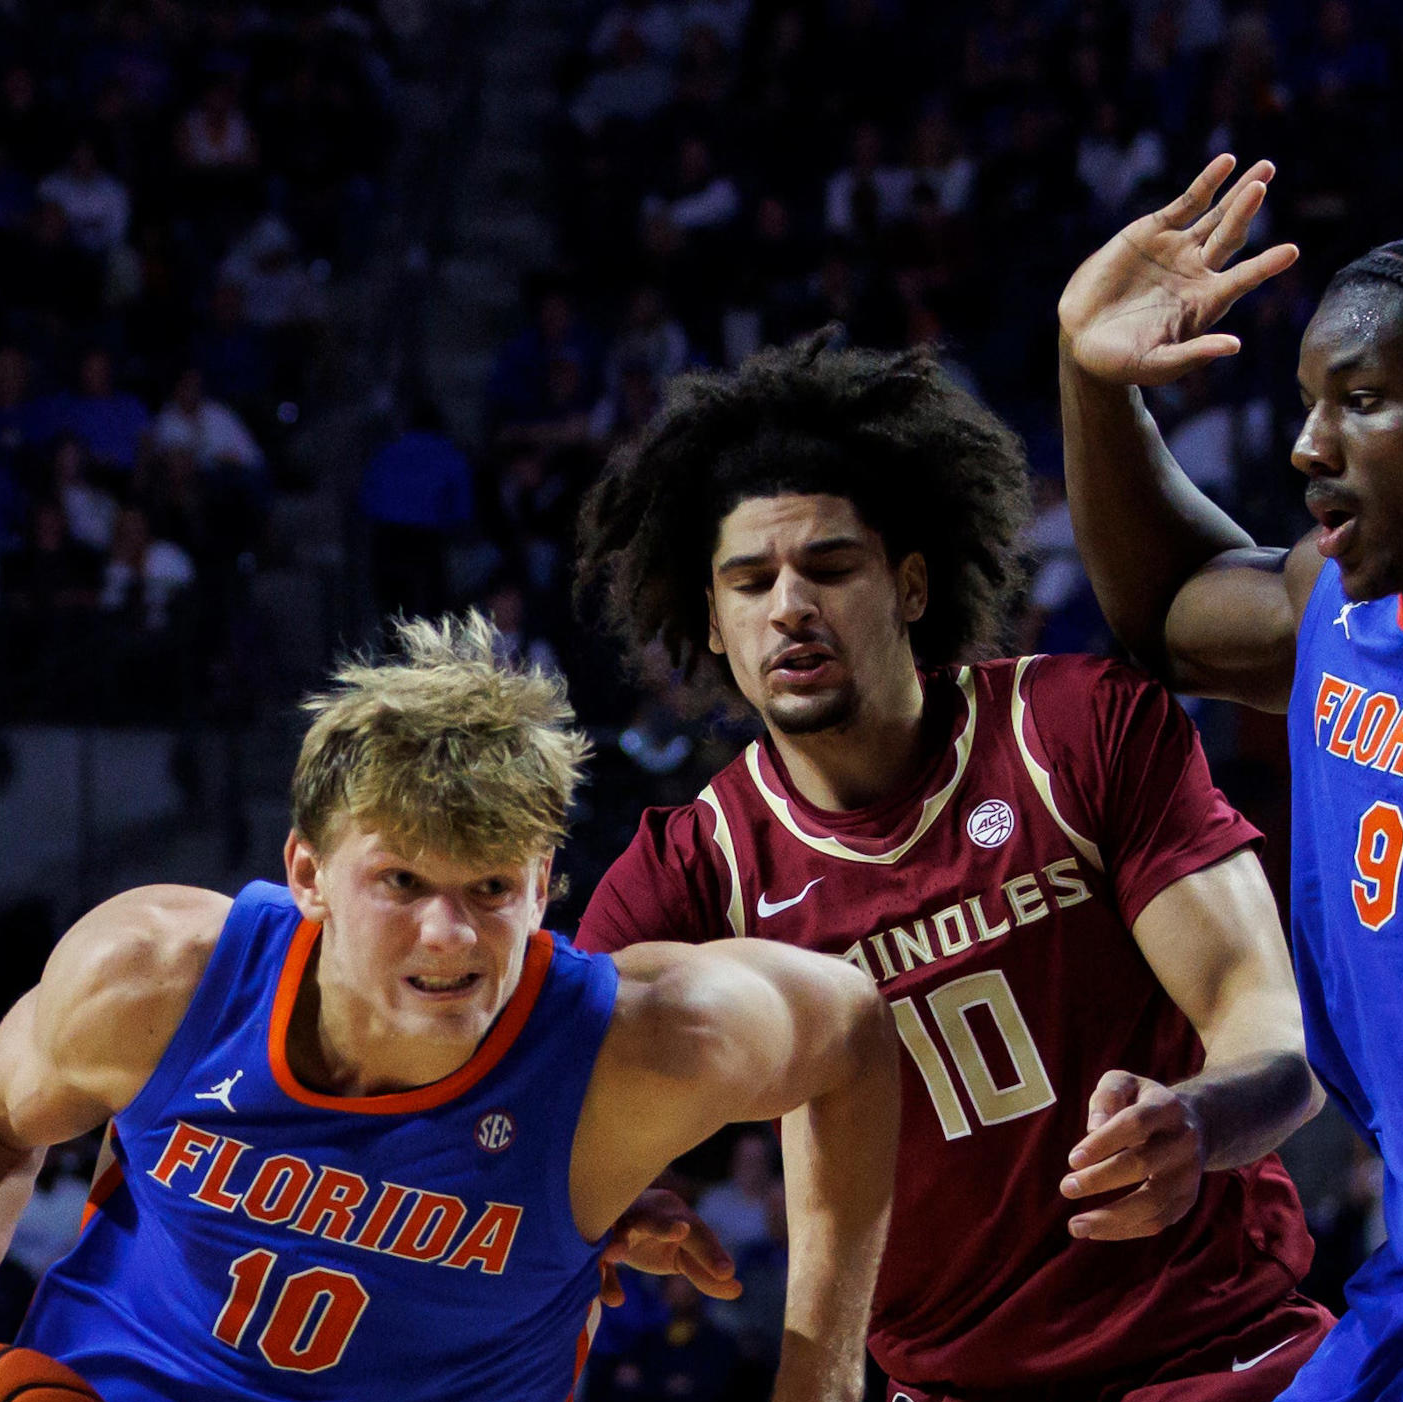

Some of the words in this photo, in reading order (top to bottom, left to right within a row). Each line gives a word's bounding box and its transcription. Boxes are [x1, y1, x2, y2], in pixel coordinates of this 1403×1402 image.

[976, 808, 1007, 831] ACC
[889, 968, 1058, 1141] 10
[477, 1111, 513, 1150] SEC
[146, 1120, 524, 1275] FLORIDA
[211, 1248, 370, 1374] 10
